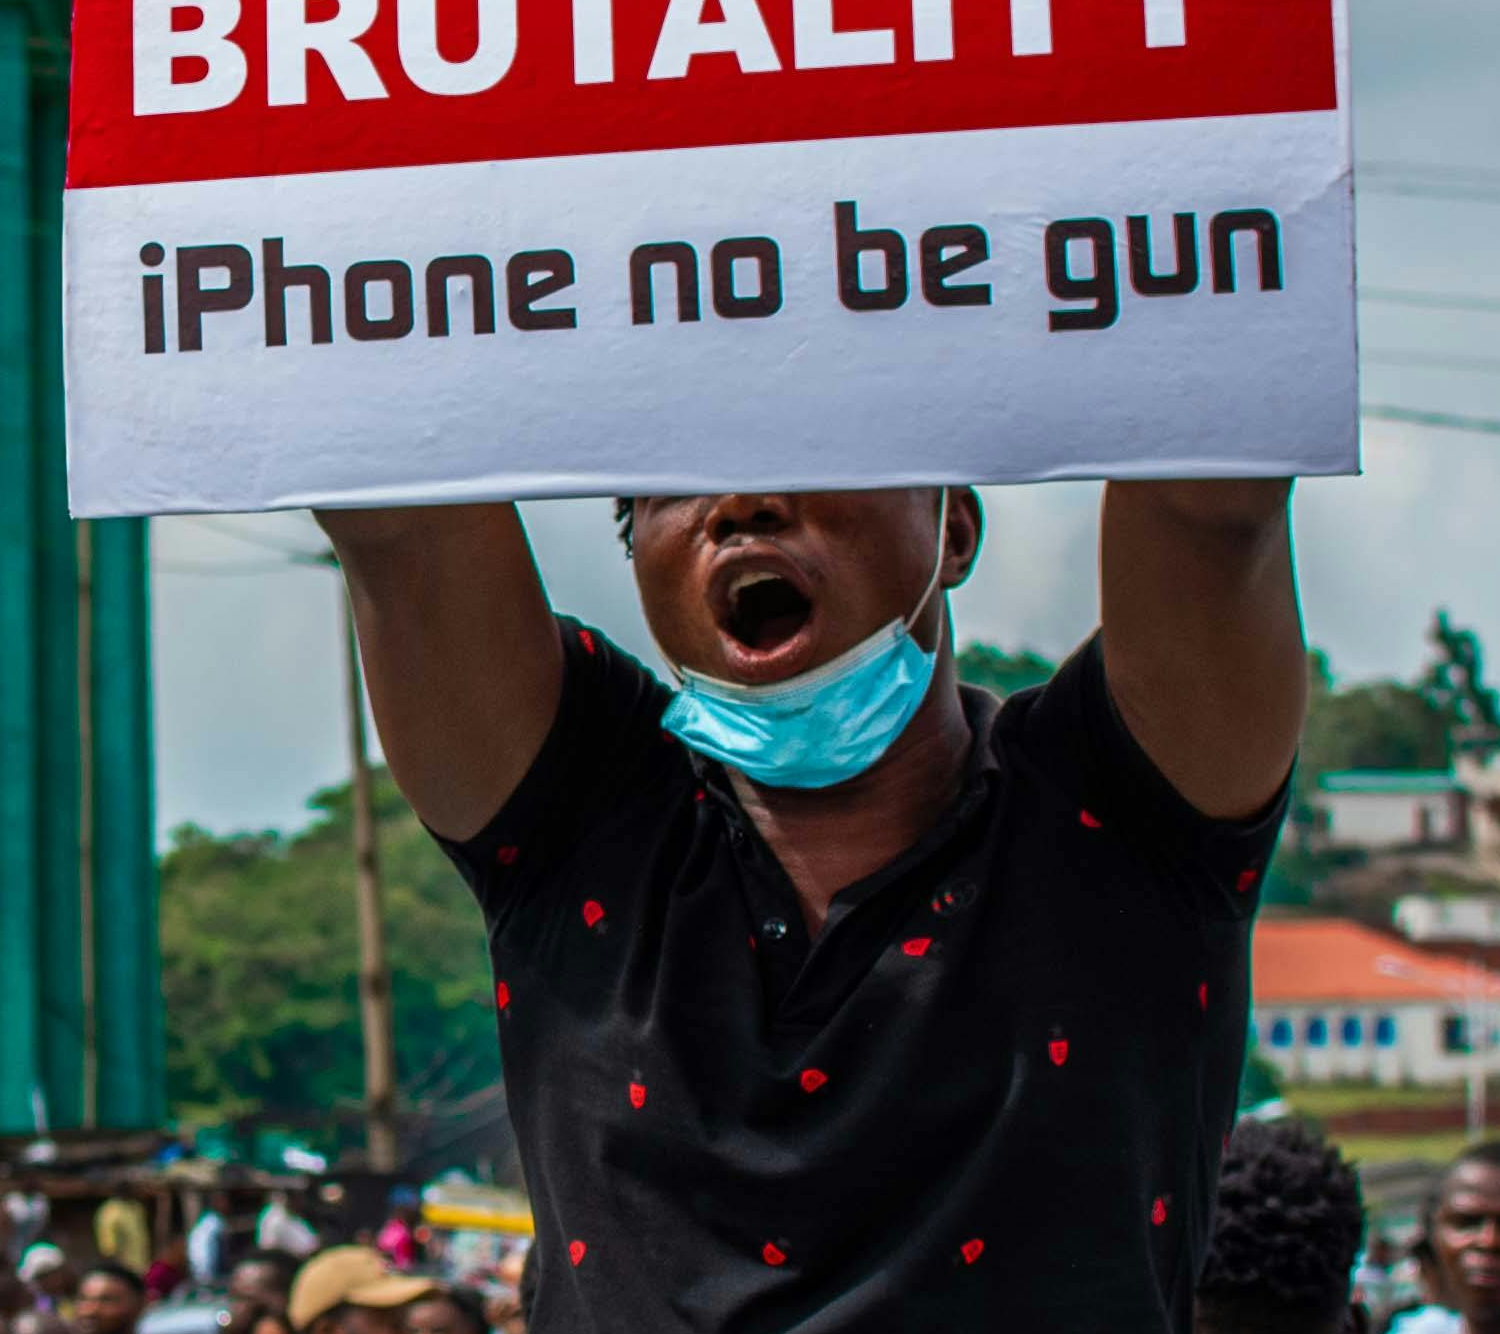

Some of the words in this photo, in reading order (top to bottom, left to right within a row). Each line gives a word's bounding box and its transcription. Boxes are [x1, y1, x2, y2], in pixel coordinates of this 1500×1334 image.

[138, 236, 578, 356] iPhone
[628, 235, 784, 327] no
[832, 199, 993, 314] be
[1043, 207, 1284, 335] gun
